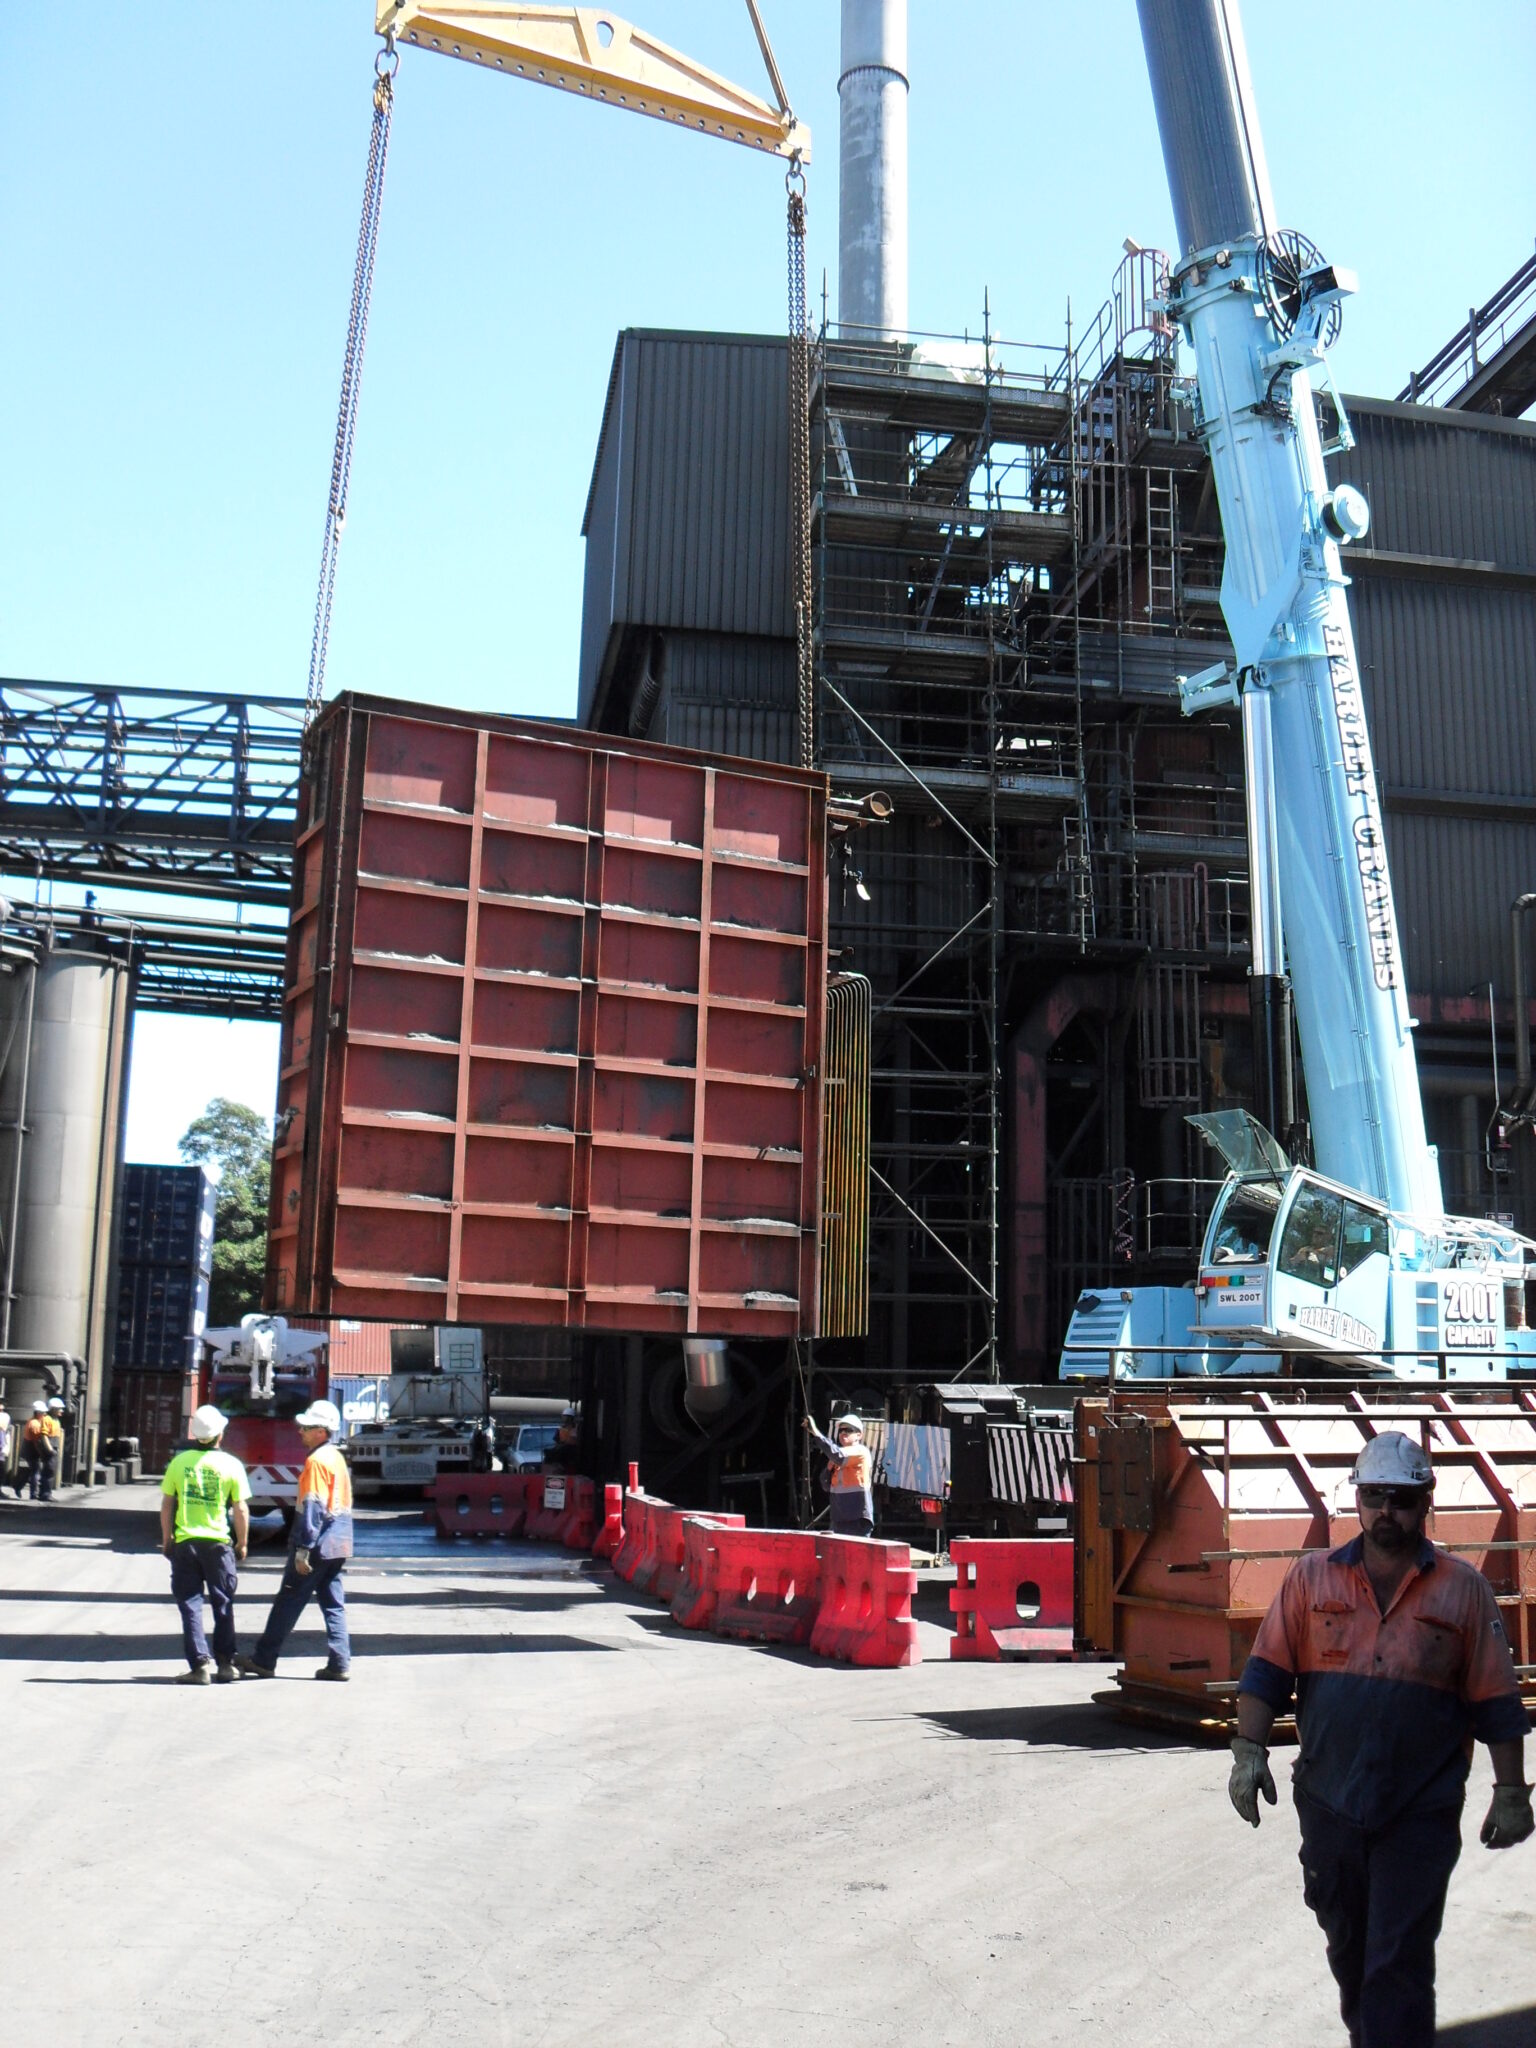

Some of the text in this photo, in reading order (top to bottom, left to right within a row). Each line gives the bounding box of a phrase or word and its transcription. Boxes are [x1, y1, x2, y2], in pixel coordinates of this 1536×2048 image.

[1322, 625, 1398, 992] HARLEY CRANES
[1220, 1293, 1261, 1303] SWL 200T
[1444, 1282, 1498, 1323] 200T
[1300, 1306, 1377, 1352] HARLEY CRANES
[1446, 1324, 1498, 1348] CAPACITY
